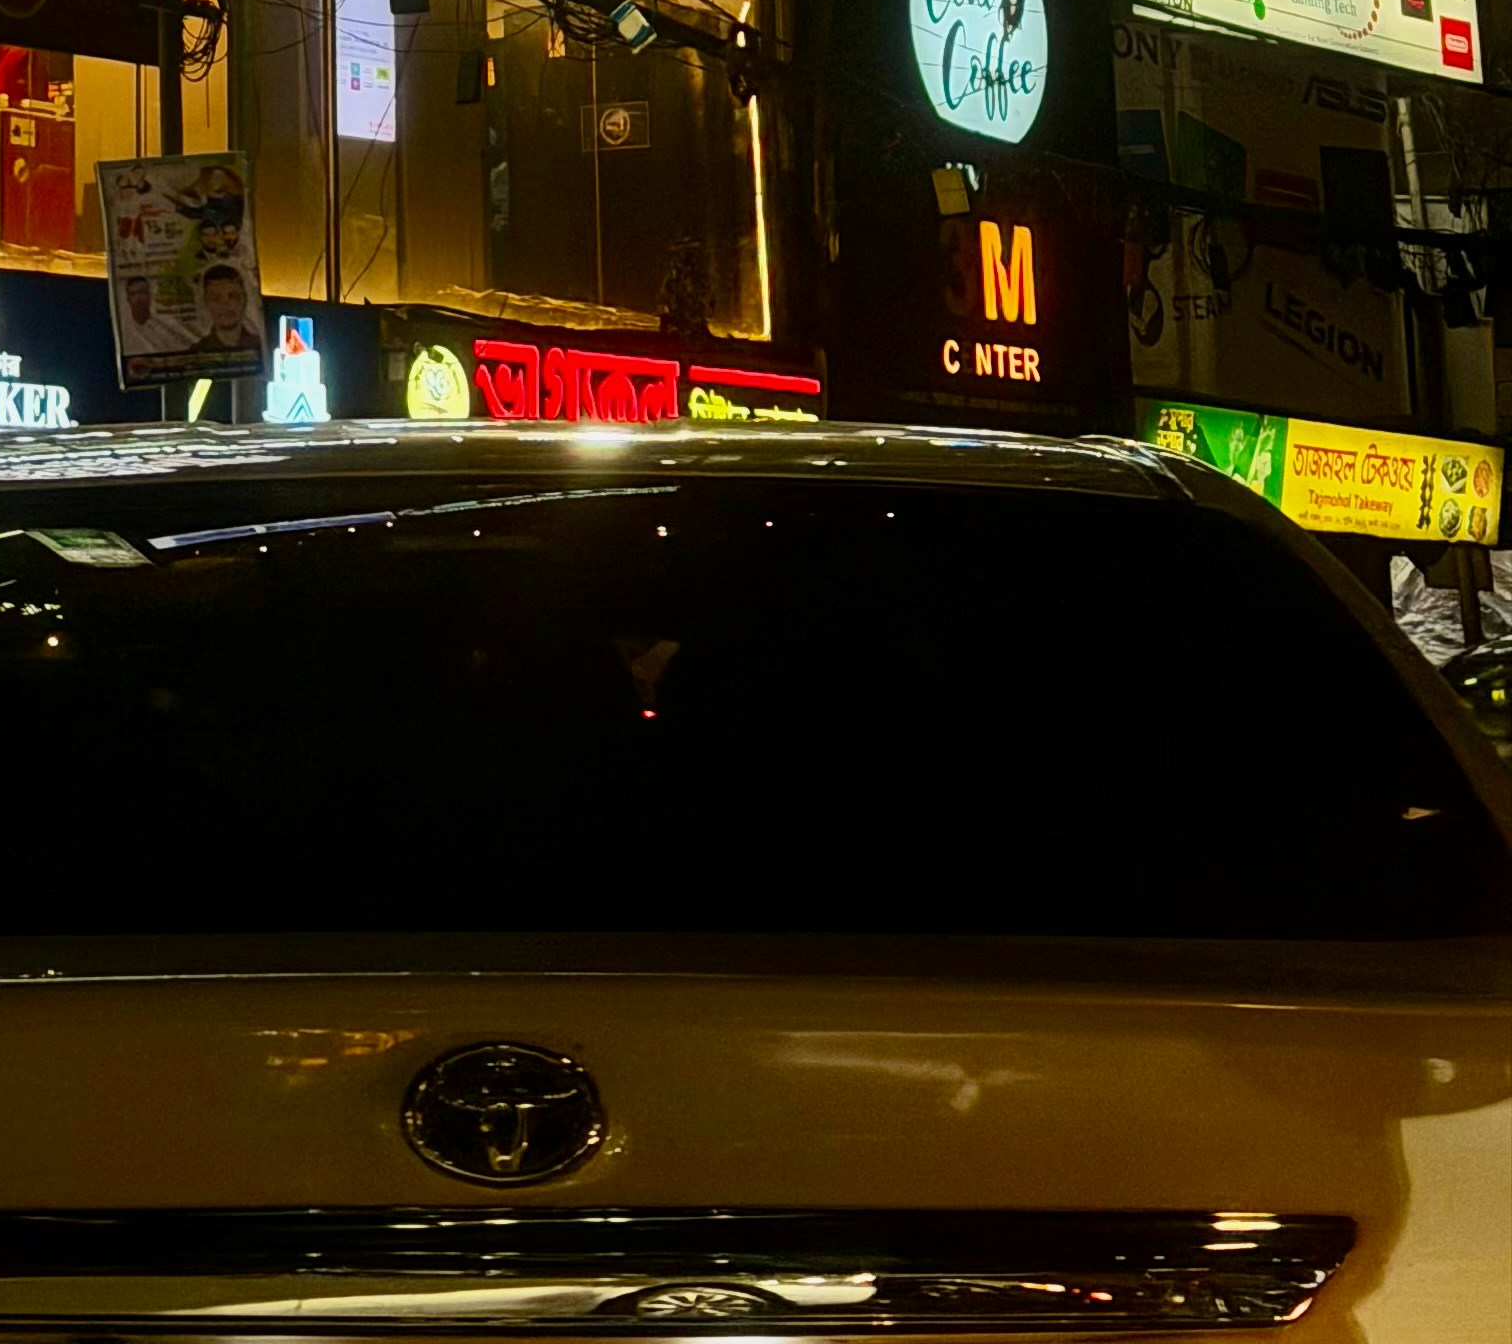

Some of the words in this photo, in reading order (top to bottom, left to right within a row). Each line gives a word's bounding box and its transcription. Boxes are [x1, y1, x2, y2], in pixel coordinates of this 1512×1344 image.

[942, 19, 1037, 122] Coffee
[942, 338, 1042, 383] CNTER
[1266, 282, 1383, 382] LEGION
[1292, 444, 1358, 484] তাজমহল
